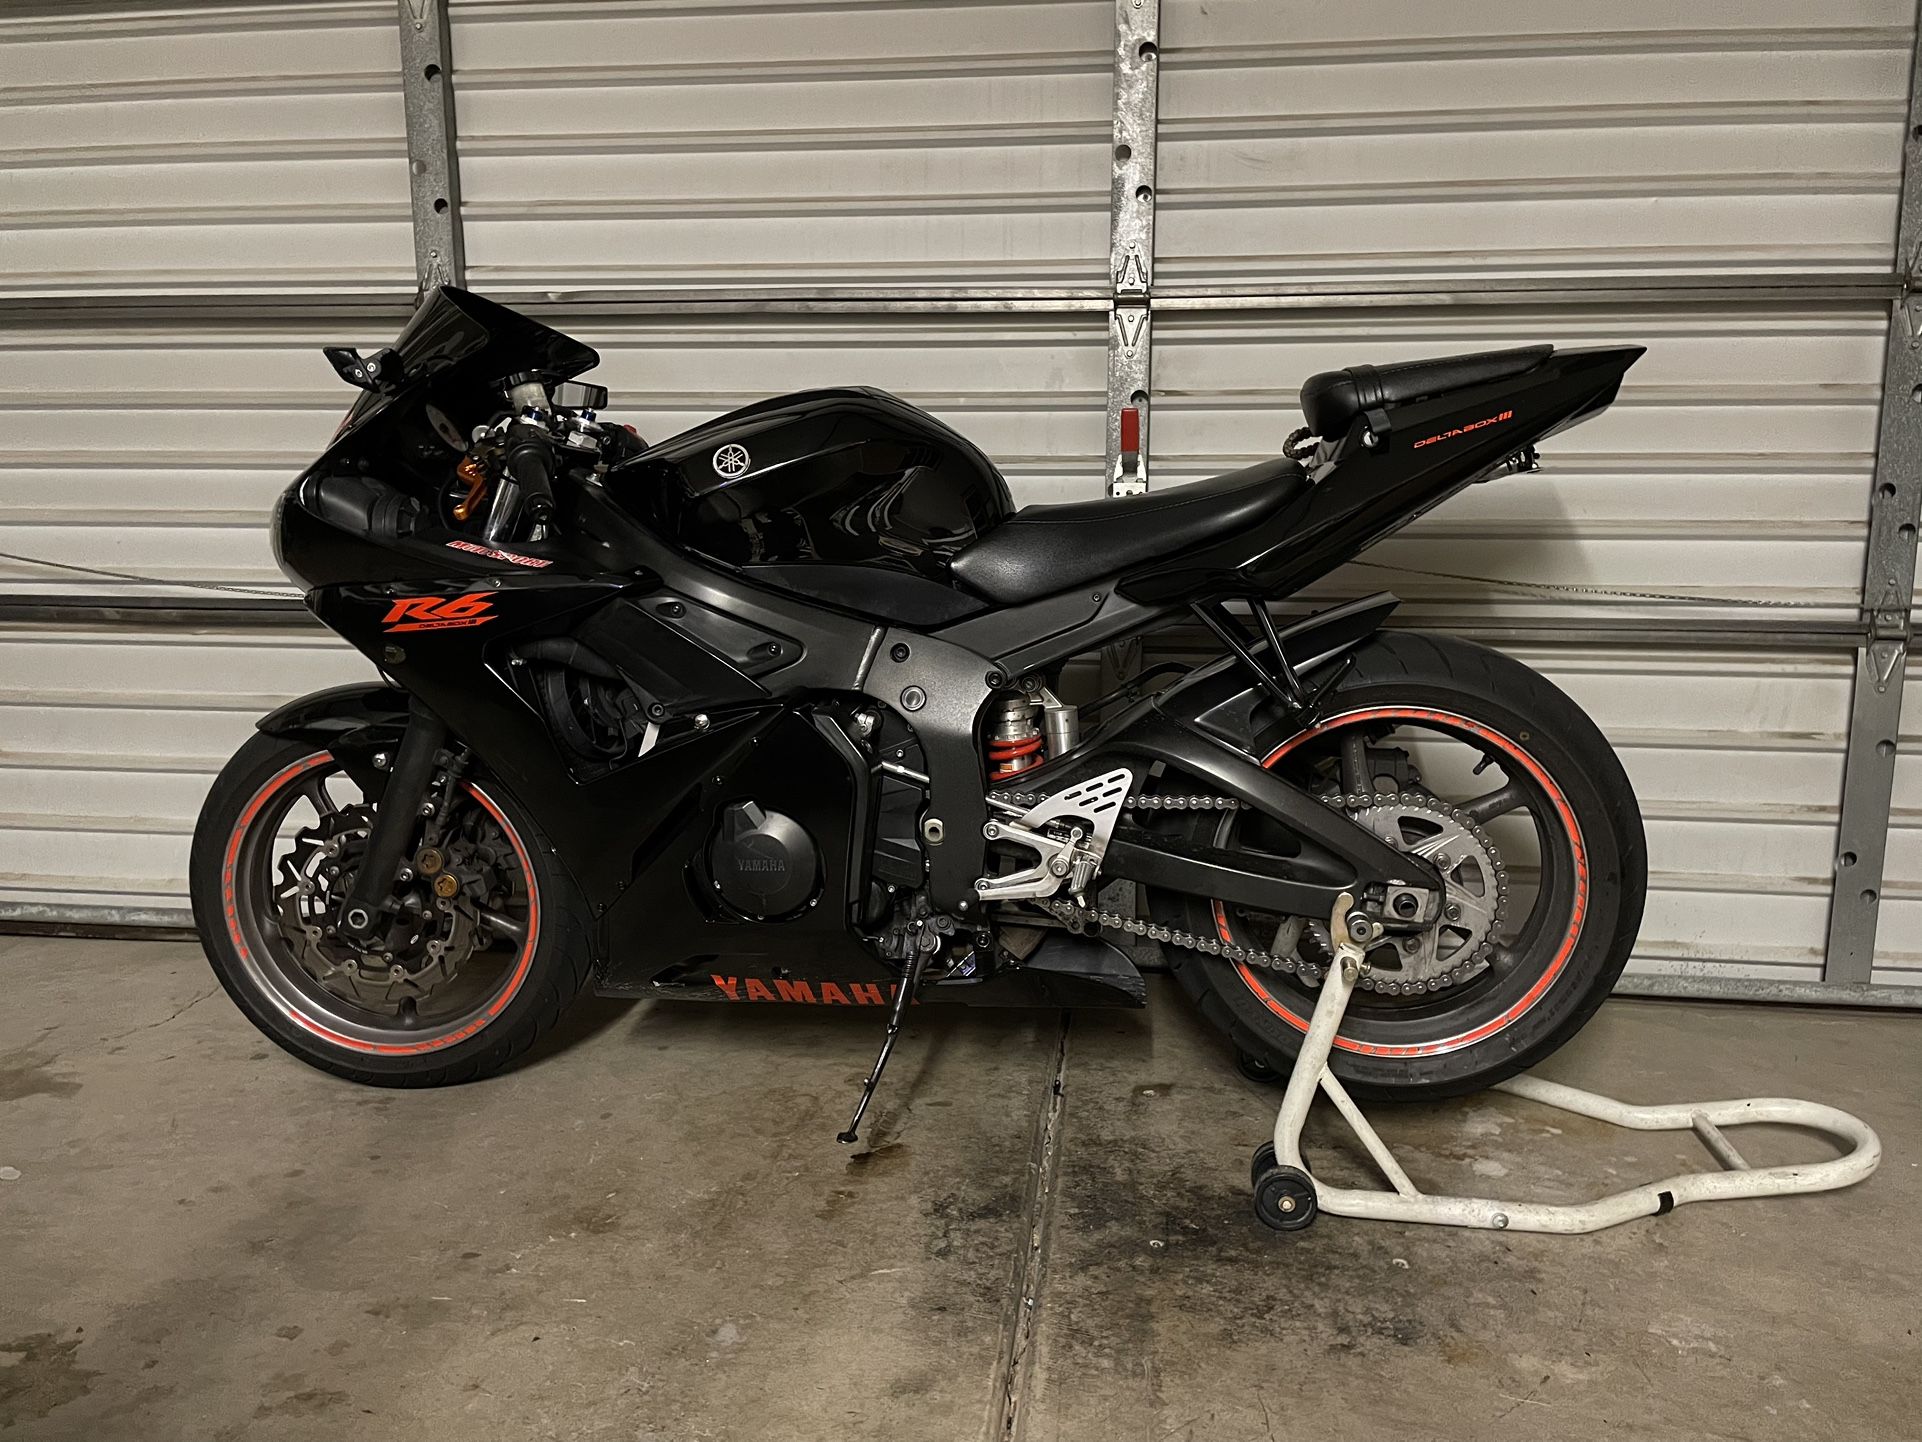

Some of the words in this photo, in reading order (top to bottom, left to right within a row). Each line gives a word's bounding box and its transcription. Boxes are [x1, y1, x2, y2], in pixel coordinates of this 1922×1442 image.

[381, 591, 499, 623] R6
[738, 859, 786, 872] YAMAHA
[710, 974, 921, 1006] YAMAH
